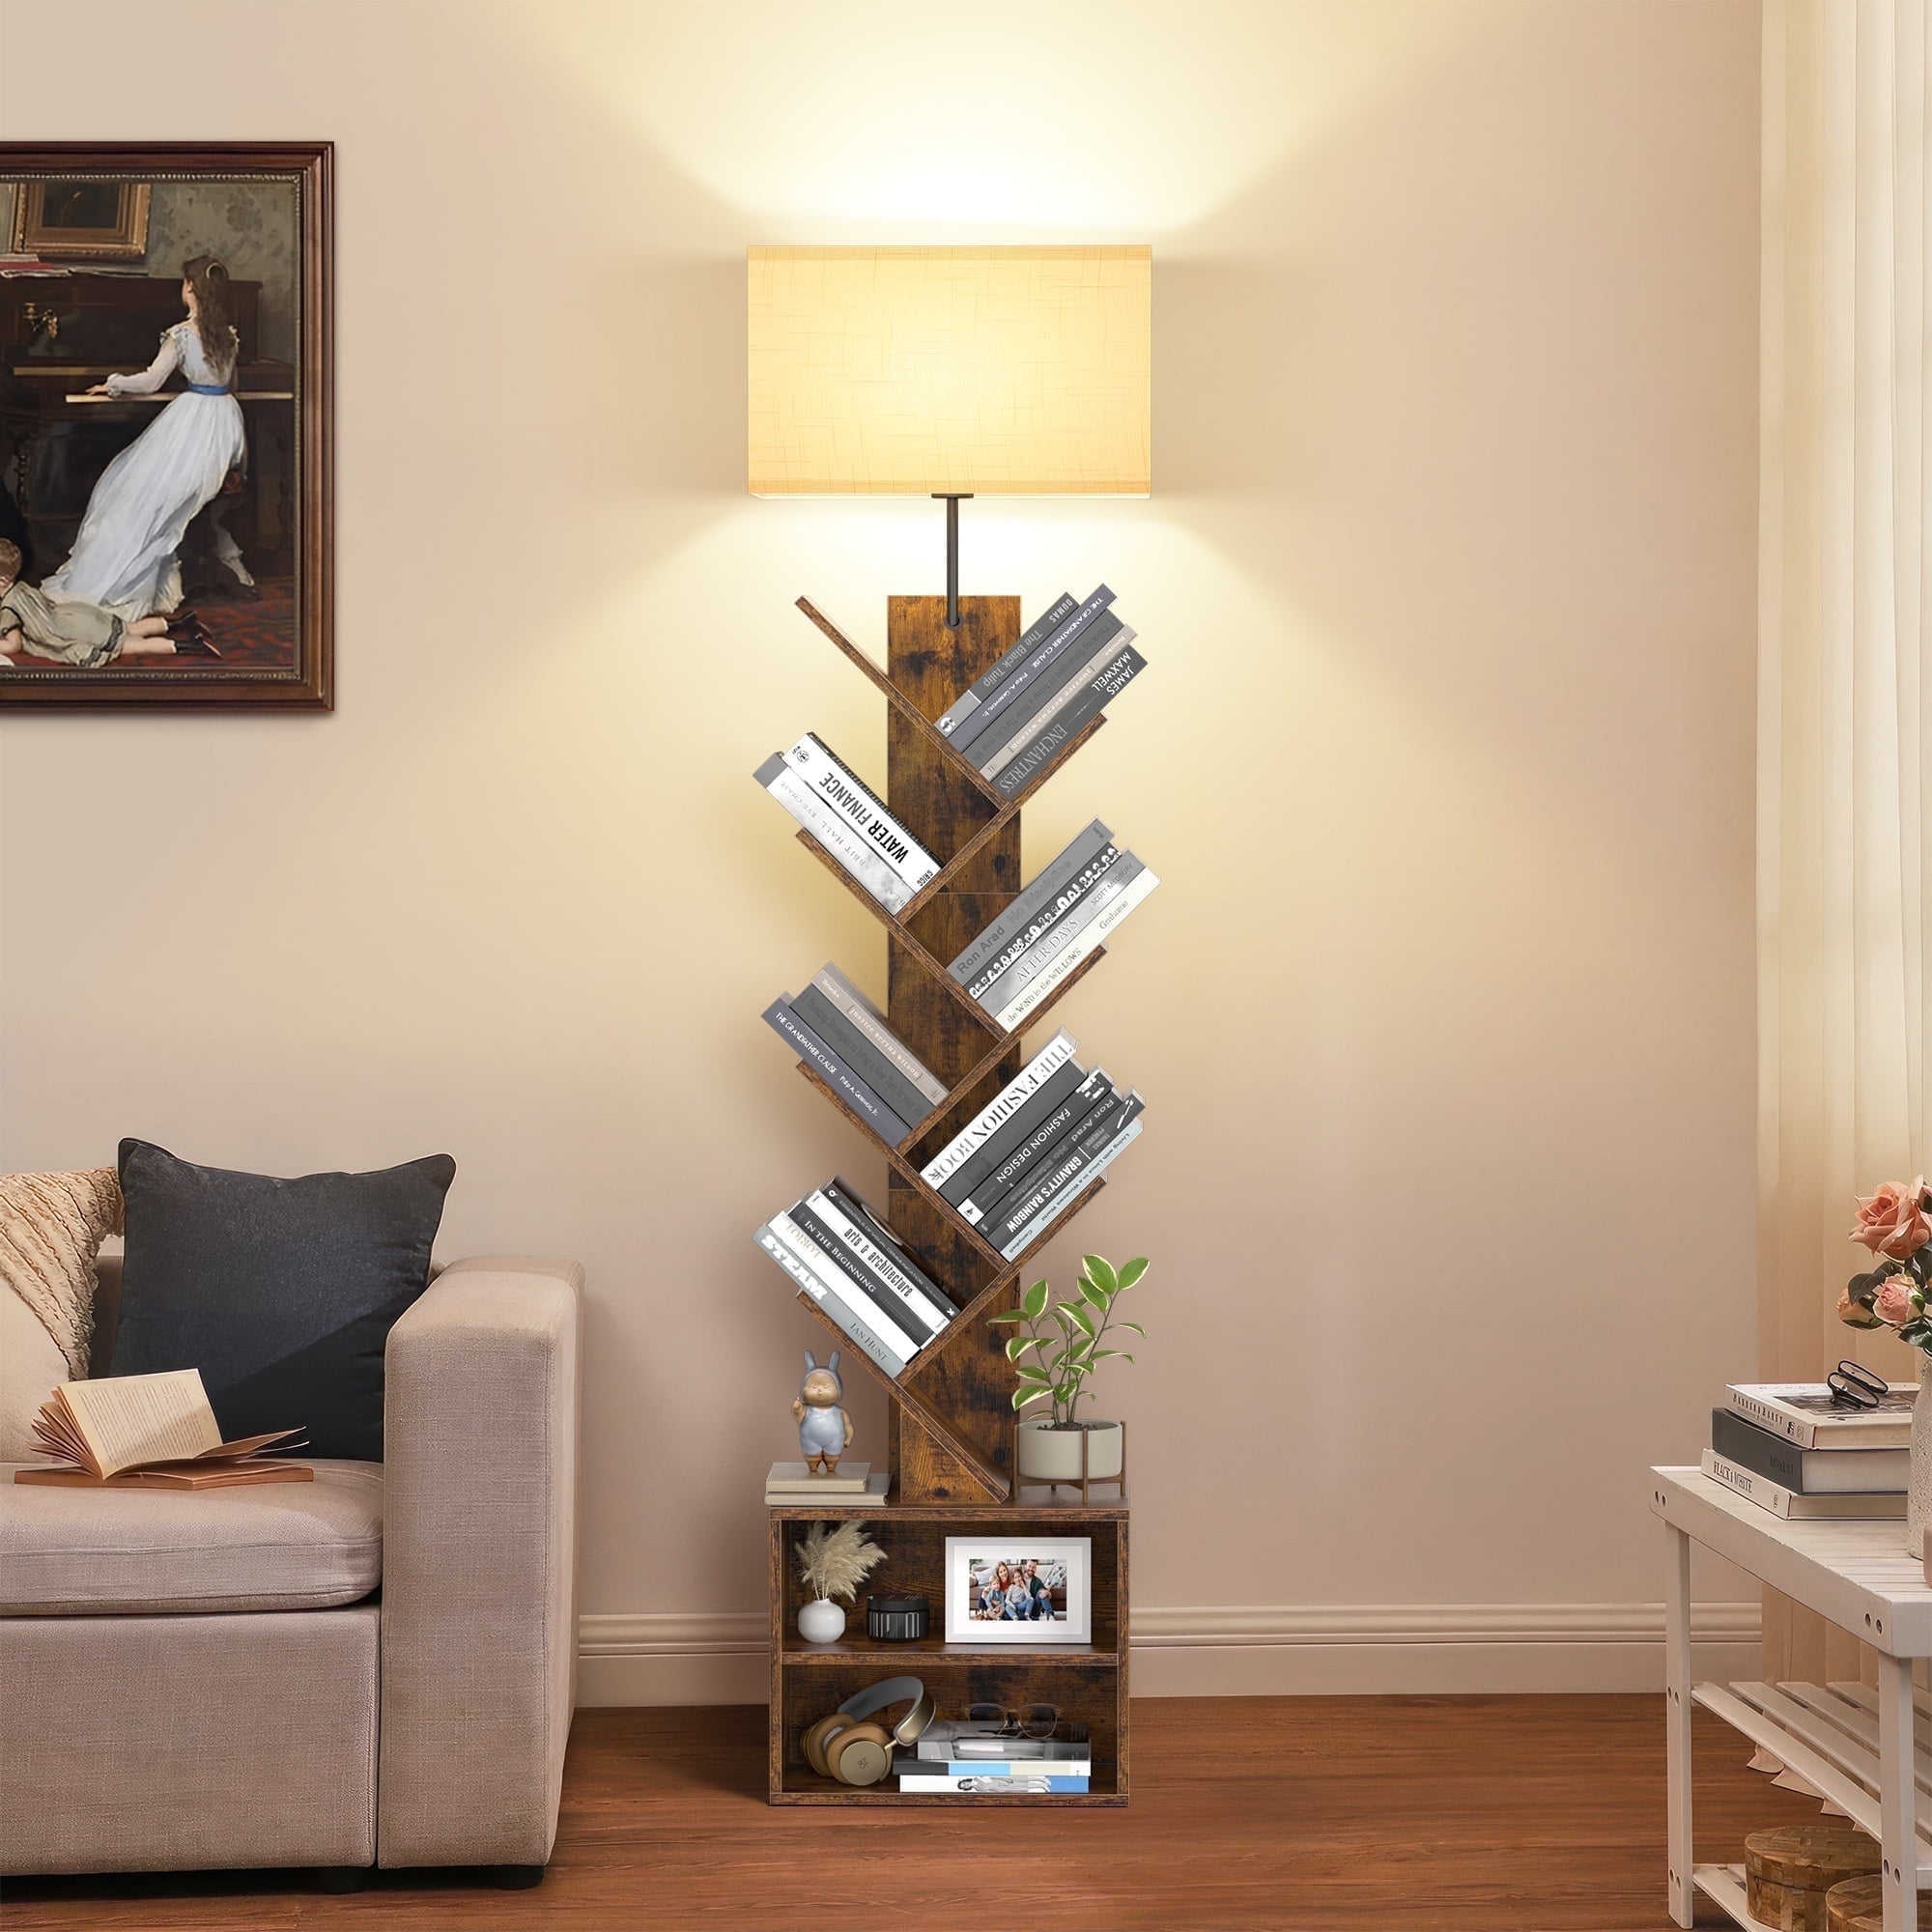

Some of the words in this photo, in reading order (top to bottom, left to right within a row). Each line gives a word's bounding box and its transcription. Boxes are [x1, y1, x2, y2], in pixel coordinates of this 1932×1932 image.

[1048, 599, 1072, 622] DUMAS
[1090, 598, 1102, 610] THE
[1023, 630, 1042, 648] The
[1052, 609, 1092, 647] GRANDFATHER
[1002, 645, 1027, 669] Black
[1032, 647, 1053, 668] CLAUSE
[1092, 653, 1131, 692] MAXWELL
[981, 665, 1005, 688] Tulip
[1106, 666, 1134, 695] JAMES
[999, 724, 1067, 792] ENCHANTRESS
[820, 773, 871, 824] FINANCE
[820, 821, 843, 844] HALL
[867, 821, 909, 862] WATER
[917, 870, 933, 887] GRIGG
[1092, 888, 1109, 905] SCOTT
[958, 952, 980, 974] Ron
[979, 926, 1005, 952] Arad
[1015, 947, 1050, 981] AFTER
[1049, 919, 1078, 948] DAYS
[1039, 979, 1051, 989] the
[1049, 949, 1082, 980] WILLOWS
[776, 1013, 786, 1024] THE
[785, 1022, 819, 1056] GRANDFATHER
[817, 1054, 838, 1074] CLAUSE
[1036, 1043, 1070, 1077] THE
[972, 1075, 1037, 1141] FASHION
[1094, 1100, 1114, 1119] Ron
[1030, 1109, 1070, 1149] FASHION
[1071, 1120, 1094, 1142] Arad
[1113, 1133, 1130, 1150] Living
[996, 1149, 1031, 1182] DESIGN
[1089, 1160, 1103, 1175] Linux
[1102, 1149, 1114, 1161] with
[1040, 1156, 1082, 1197] GRAVITY'S
[1056, 1183, 1080, 1207] Windows
[1007, 1194, 1044, 1232] RAINBOW
[1041, 1206, 1057, 1221] World
[786, 1224, 820, 1258] LORIOT
[1009, 1229, 1033, 1254] Campbell
[762, 1235, 827, 1299] STEAM
[844, 1228, 863, 1246] arts
[868, 1251, 914, 1296] architecture
